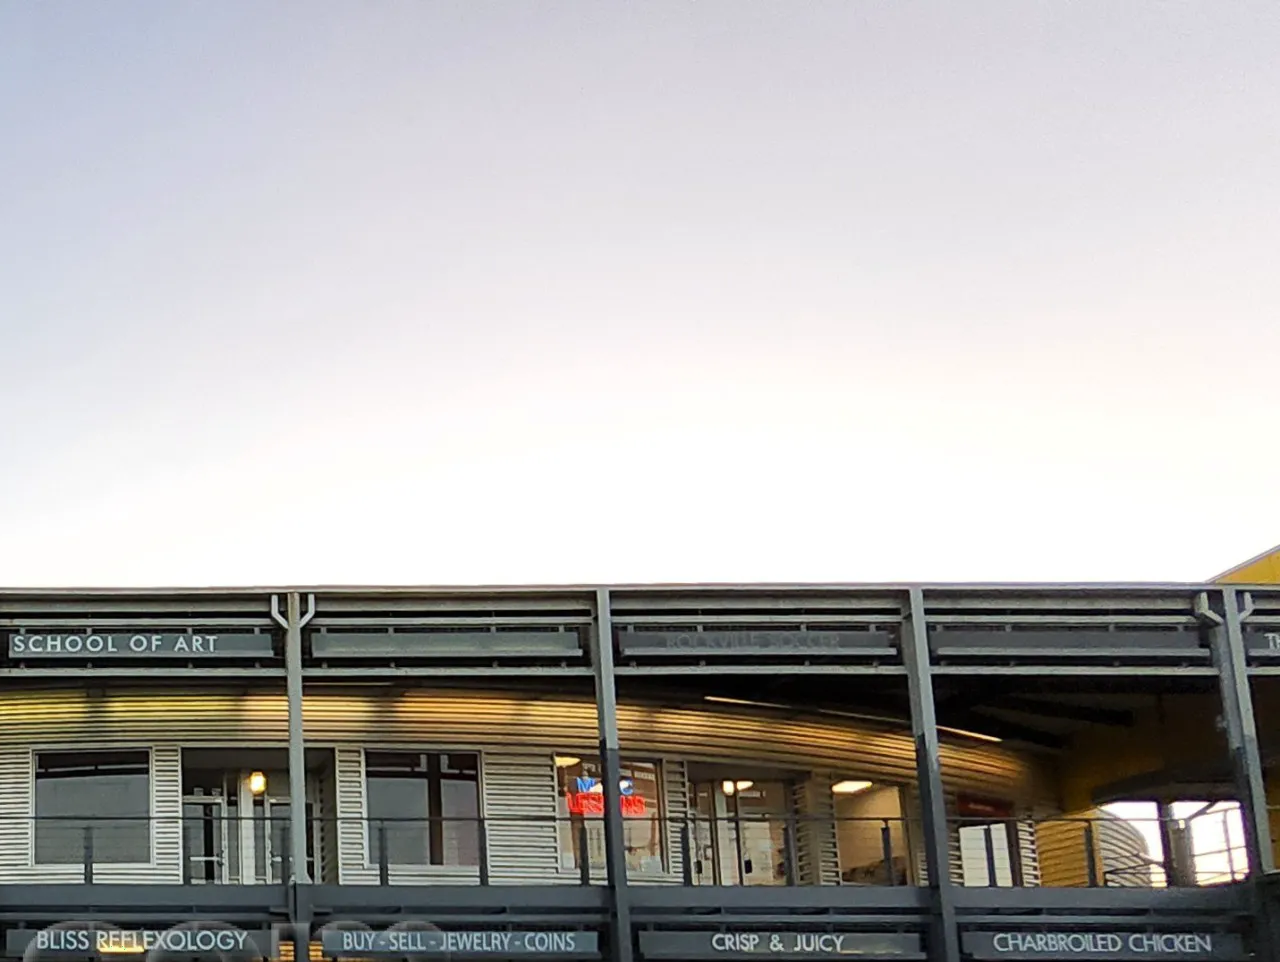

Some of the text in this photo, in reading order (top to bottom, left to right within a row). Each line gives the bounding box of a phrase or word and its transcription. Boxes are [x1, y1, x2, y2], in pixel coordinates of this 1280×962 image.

[13, 635, 219, 652] SCHOOL OF ART
[36, 930, 249, 951] BLISS REFLEXOLOGY
[343, 931, 379, 950] BUY
[389, 931, 426, 950] SELL
[440, 931, 512, 950] JEWELRY
[524, 931, 576, 951] COINS
[711, 933, 844, 952] CRISP & JUICY
[993, 933, 1213, 952] CHARBROILED CHICKEN
